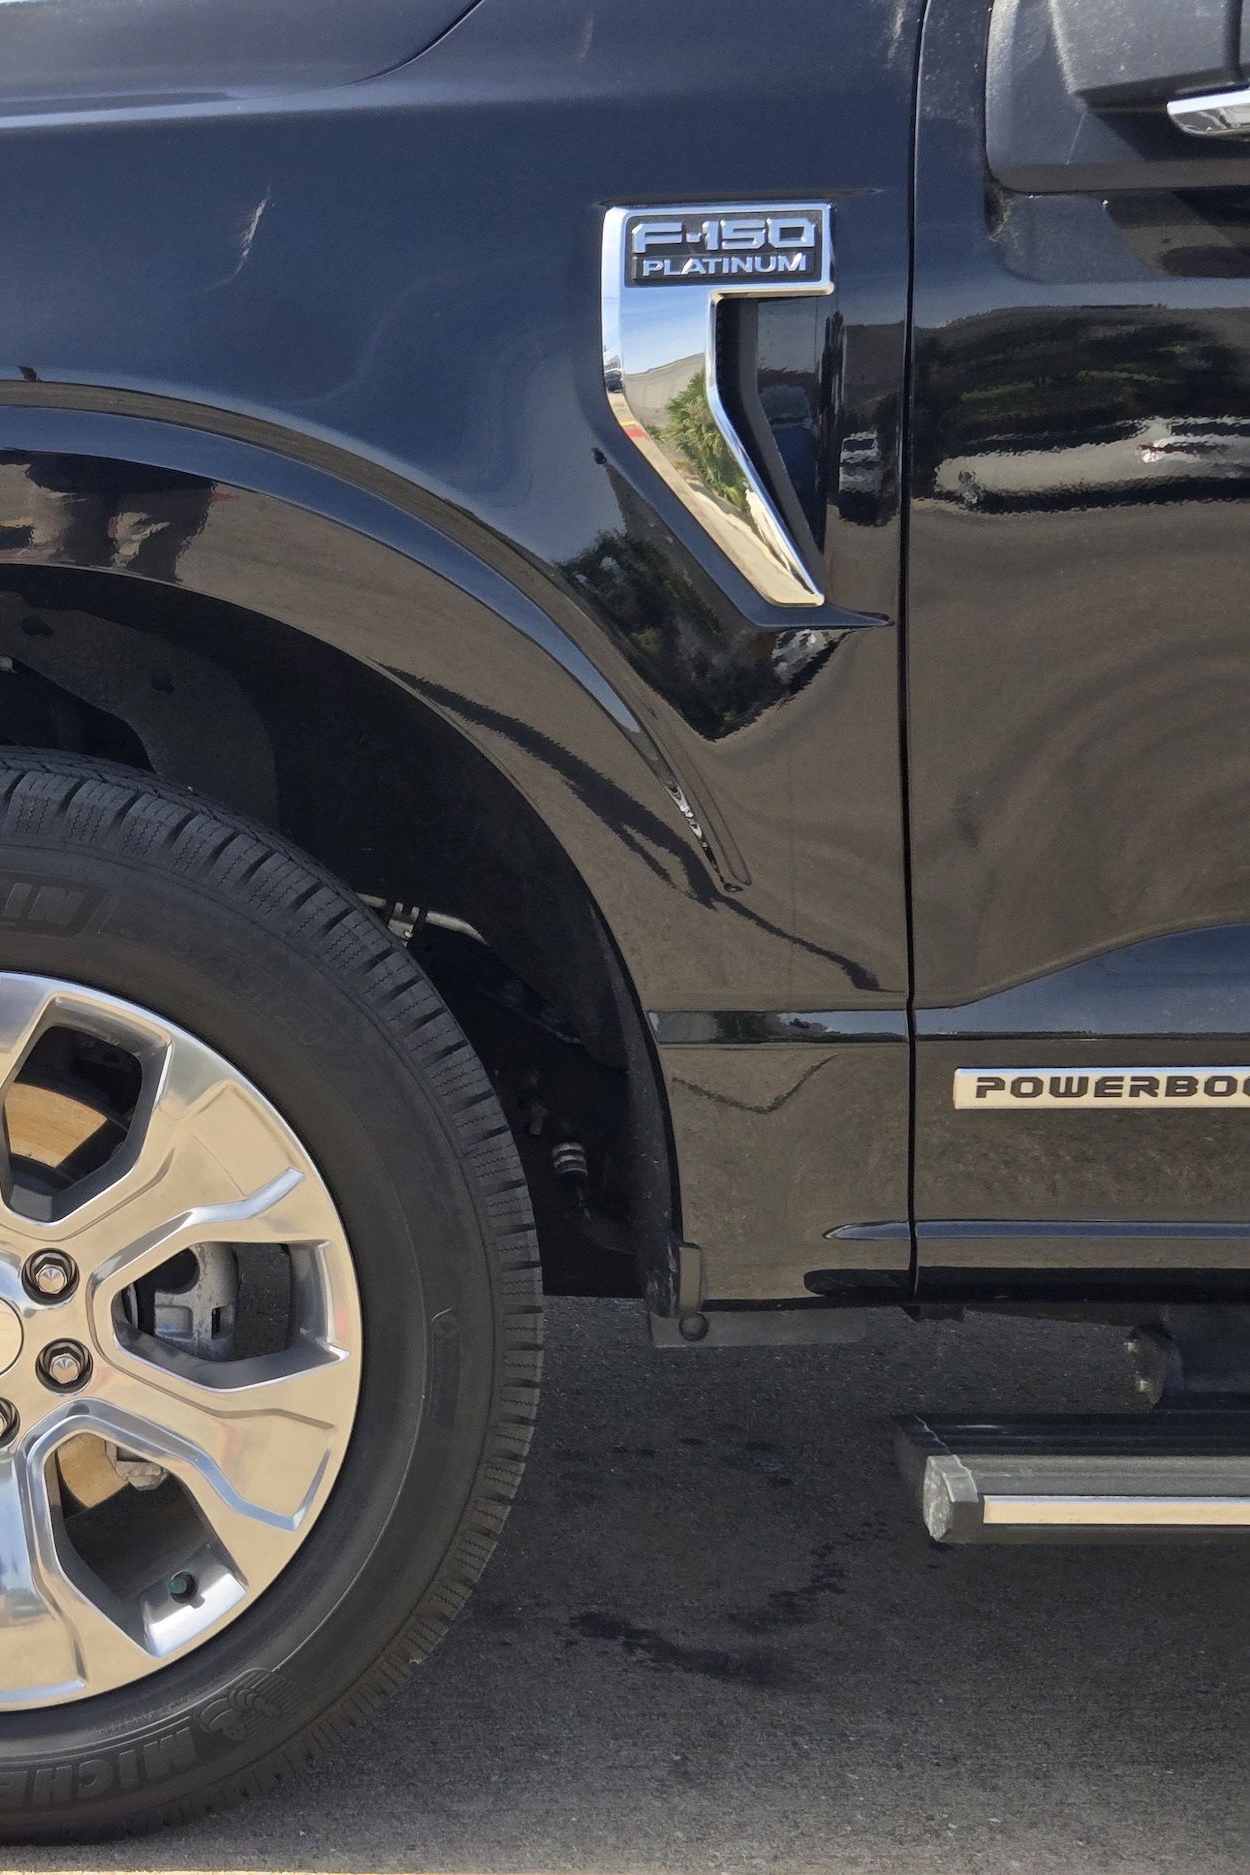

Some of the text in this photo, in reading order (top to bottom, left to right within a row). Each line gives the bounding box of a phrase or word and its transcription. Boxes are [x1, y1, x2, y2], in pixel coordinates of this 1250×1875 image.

[632, 217, 816, 254] F-150
[642, 252, 807, 277] PLATINUM
[975, 1075, 1250, 1099] POWERBO
